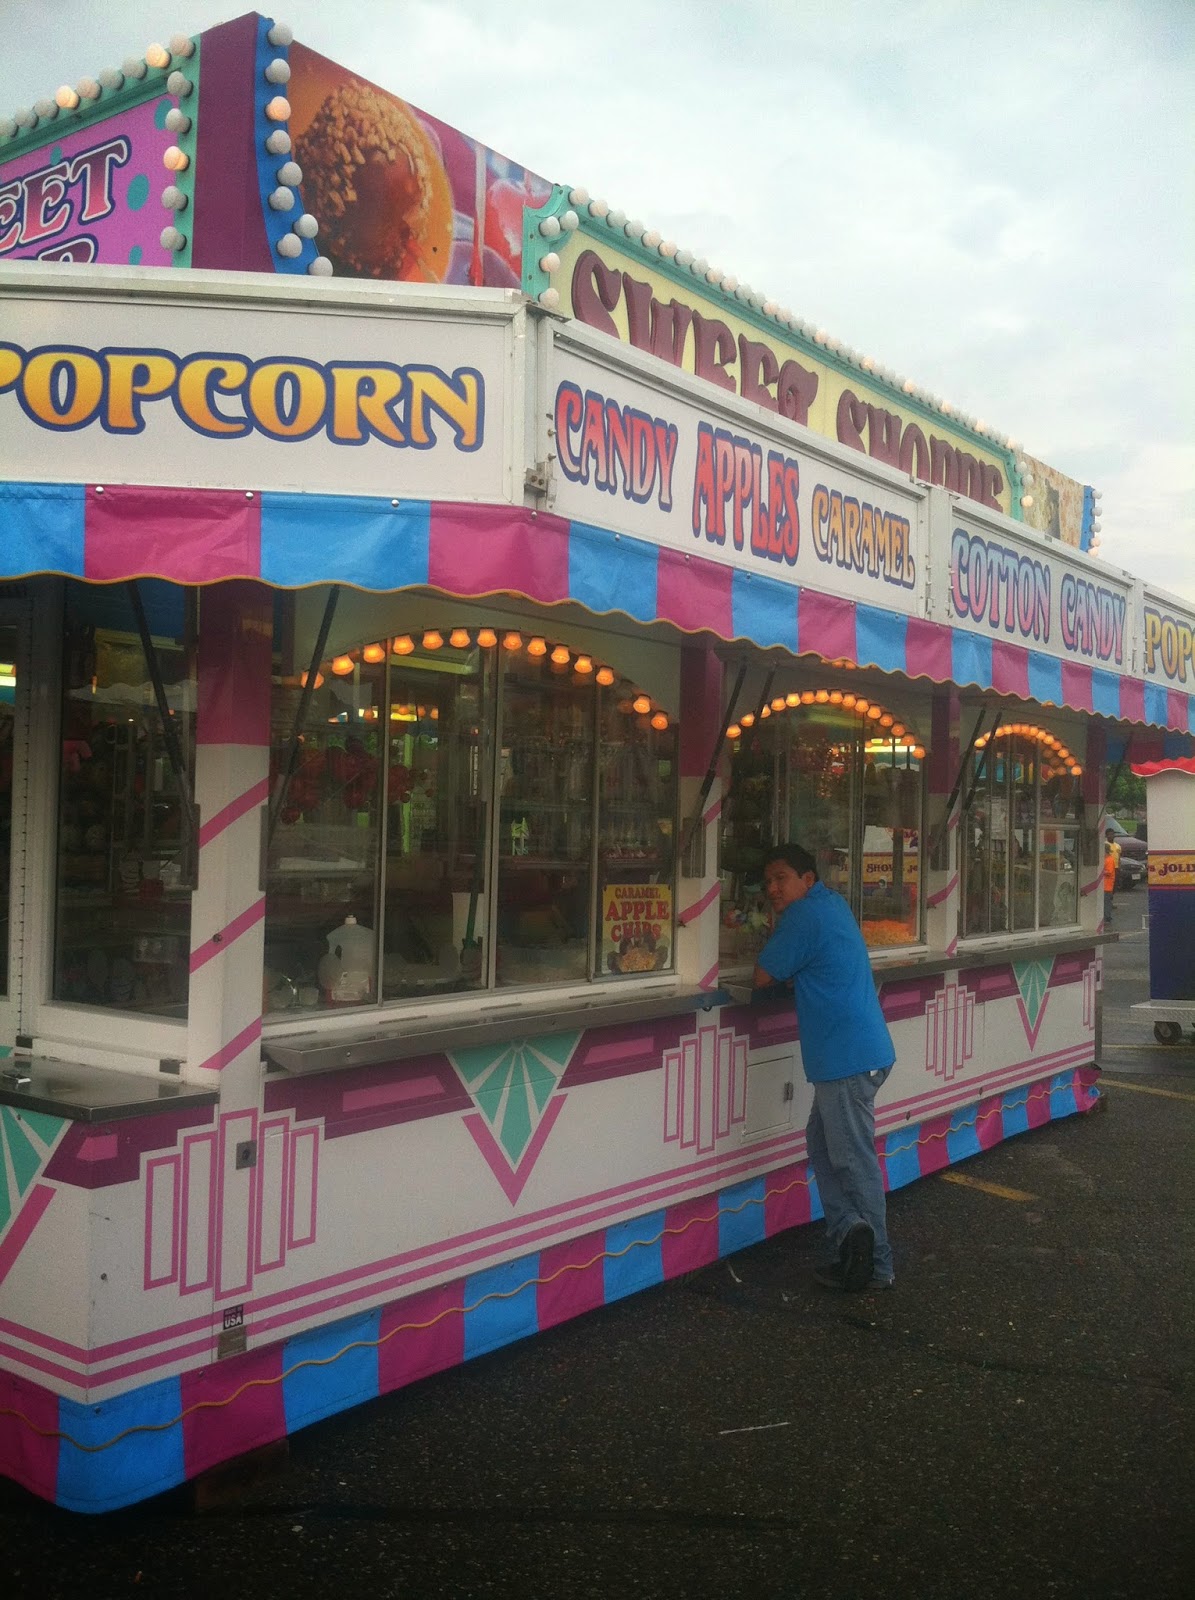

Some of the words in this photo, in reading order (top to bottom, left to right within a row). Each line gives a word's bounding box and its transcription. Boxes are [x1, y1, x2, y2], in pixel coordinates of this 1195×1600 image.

[554, 379, 678, 513] CANDY
[691, 420, 800, 566] APPLES
[811, 483, 916, 590] CARAMEL
[950, 527, 1051, 644] COTTON
[1060, 572, 1127, 665] CANDY
[1143, 605, 1195, 683] POP
[614, 887, 660, 899] CARAMEL
[604, 900, 670, 922] APPLE
[610, 921, 662, 943] CHIPS
[224, 1315, 242, 1328] USA
